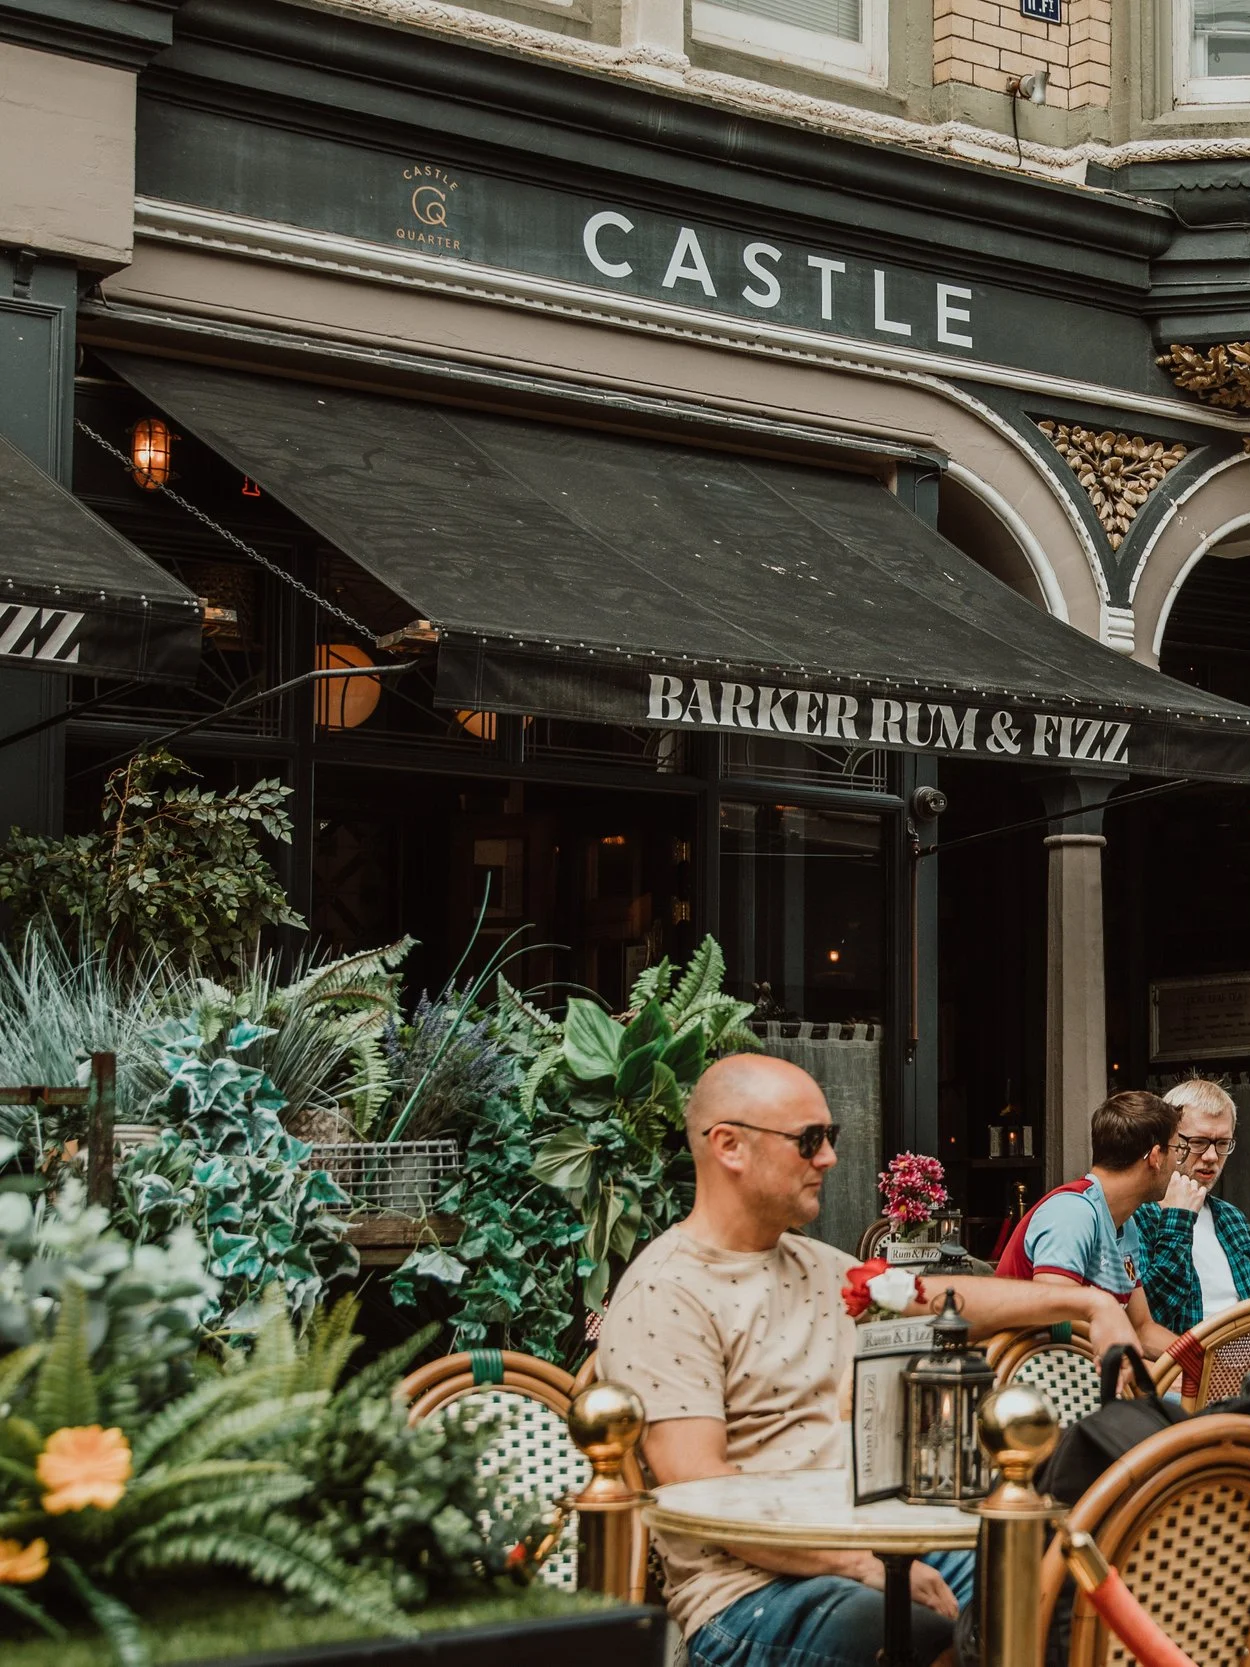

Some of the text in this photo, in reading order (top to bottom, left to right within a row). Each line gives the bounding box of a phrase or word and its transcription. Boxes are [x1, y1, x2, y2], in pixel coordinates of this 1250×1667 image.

[403, 165, 458, 192] CASTLE
[396, 228, 460, 250] QUARTER
[582, 210, 973, 349] CASTLE
[646, 673, 1132, 765] BARKER RUM & FIZZ
[864, 1331, 891, 1348] Rum
